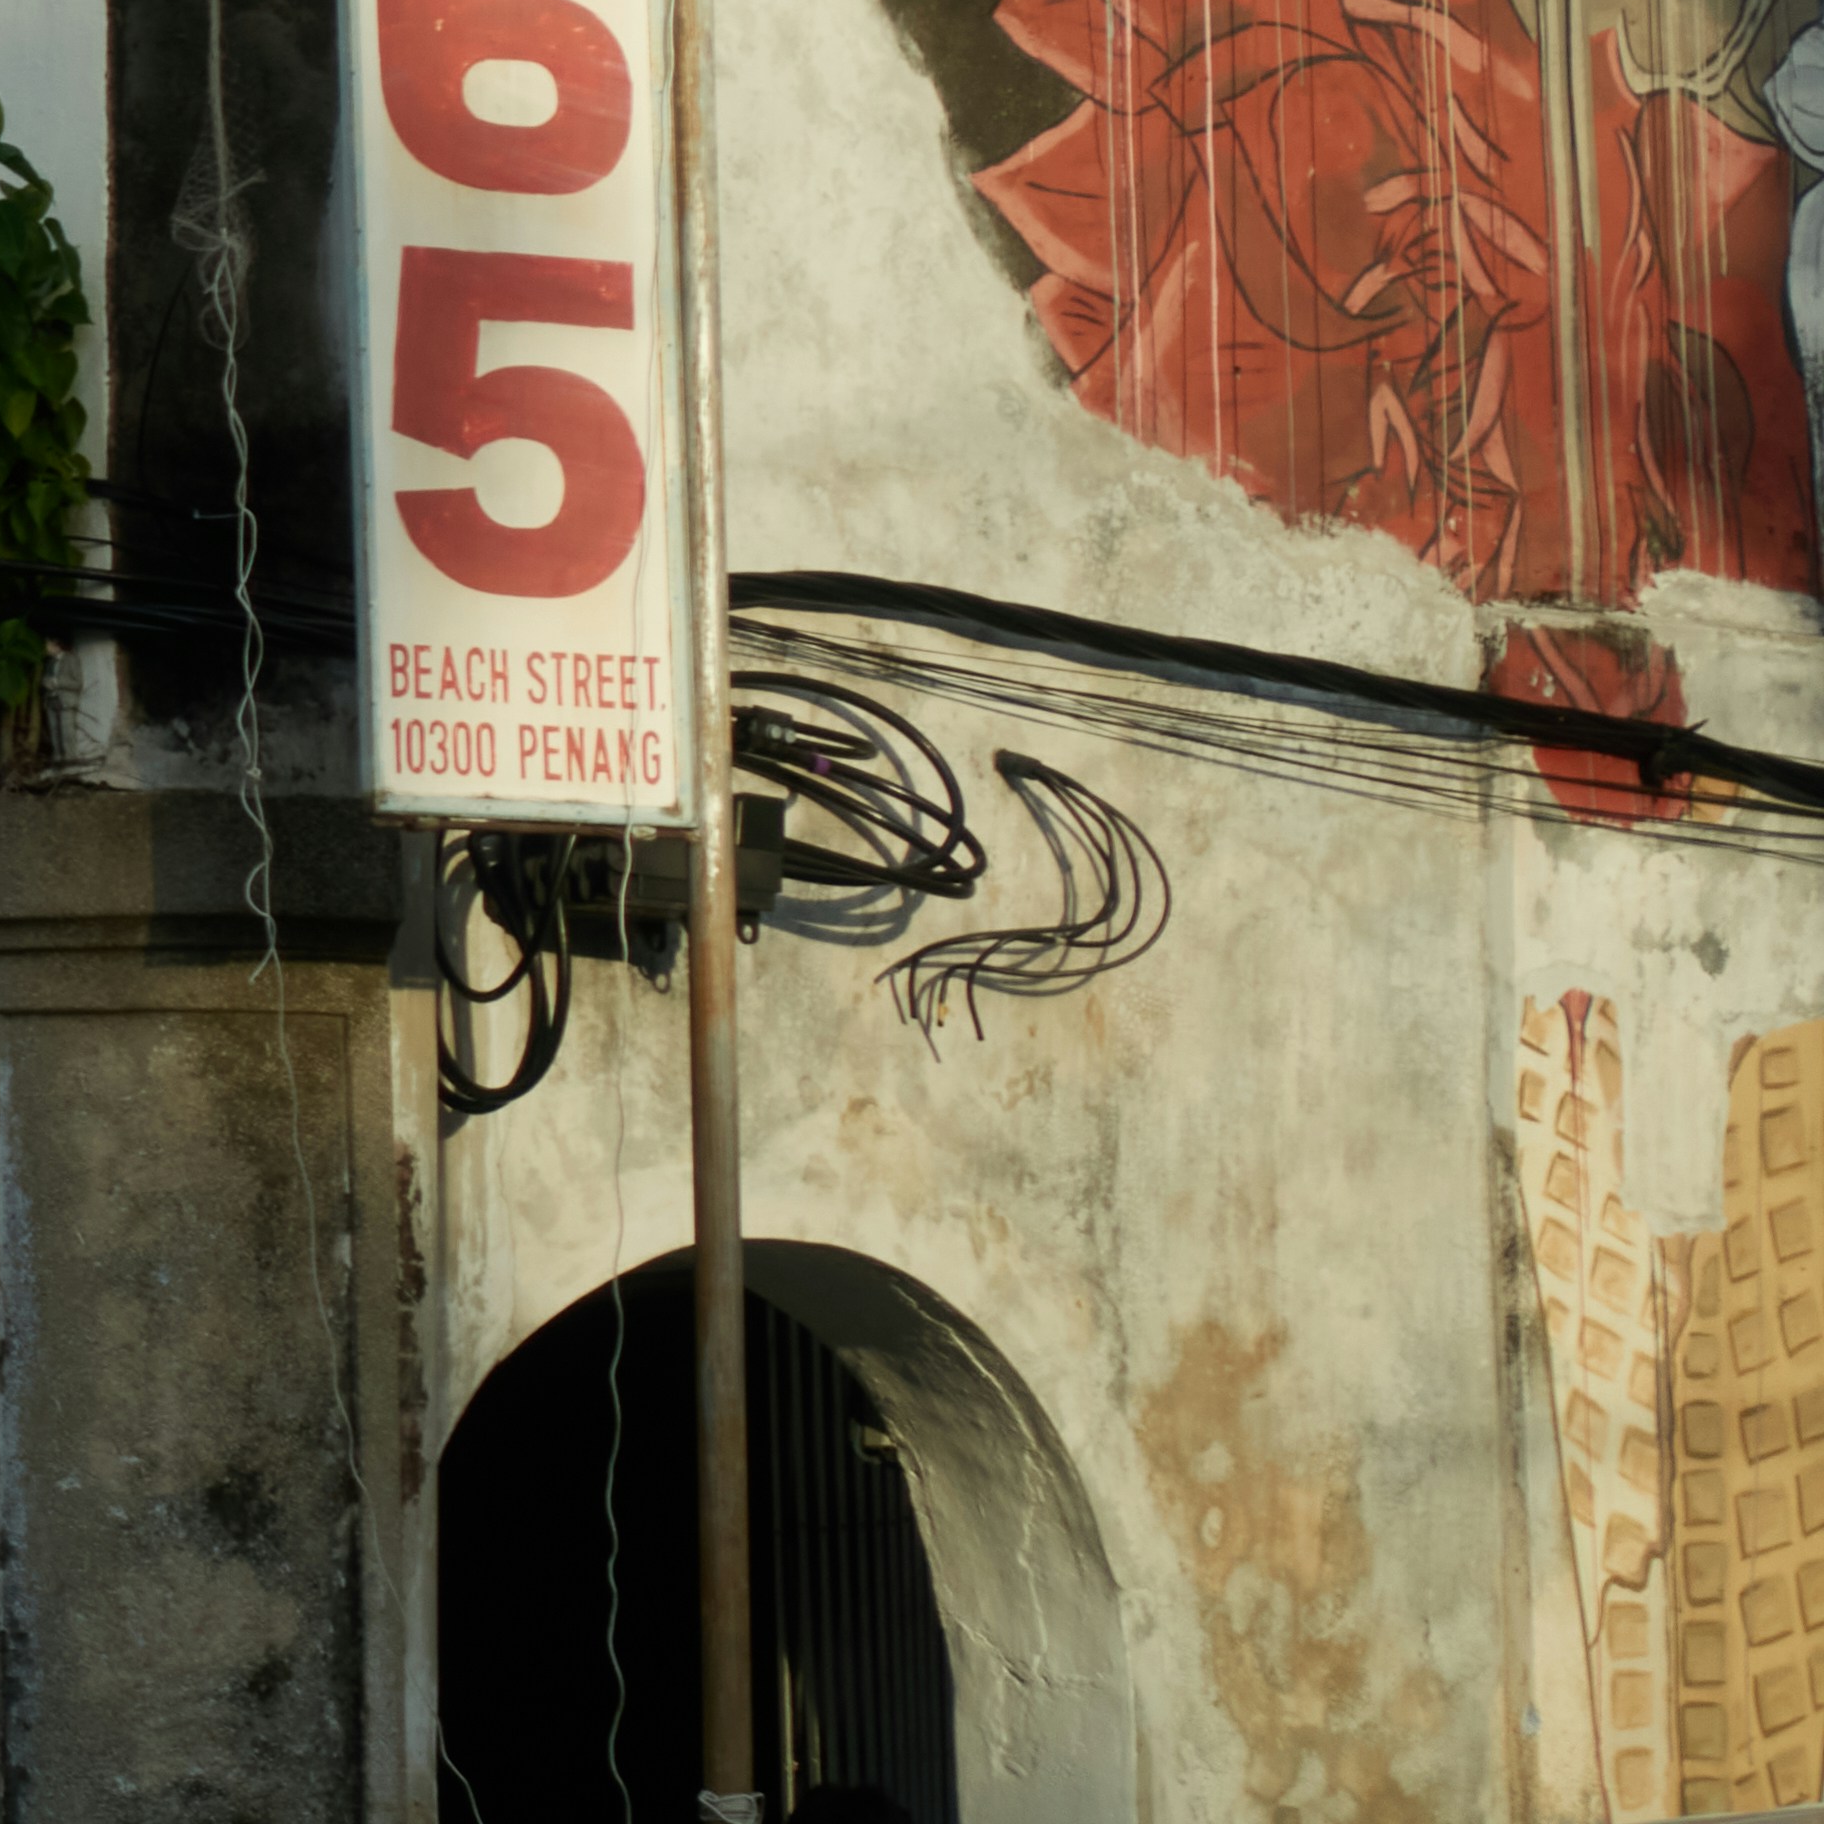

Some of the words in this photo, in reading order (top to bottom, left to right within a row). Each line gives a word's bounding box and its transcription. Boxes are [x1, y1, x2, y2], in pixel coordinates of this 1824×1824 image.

[389, 643, 510, 704] BEACH
[390, 718, 496, 777] 10300
[518, 724, 662, 786] PENANG
